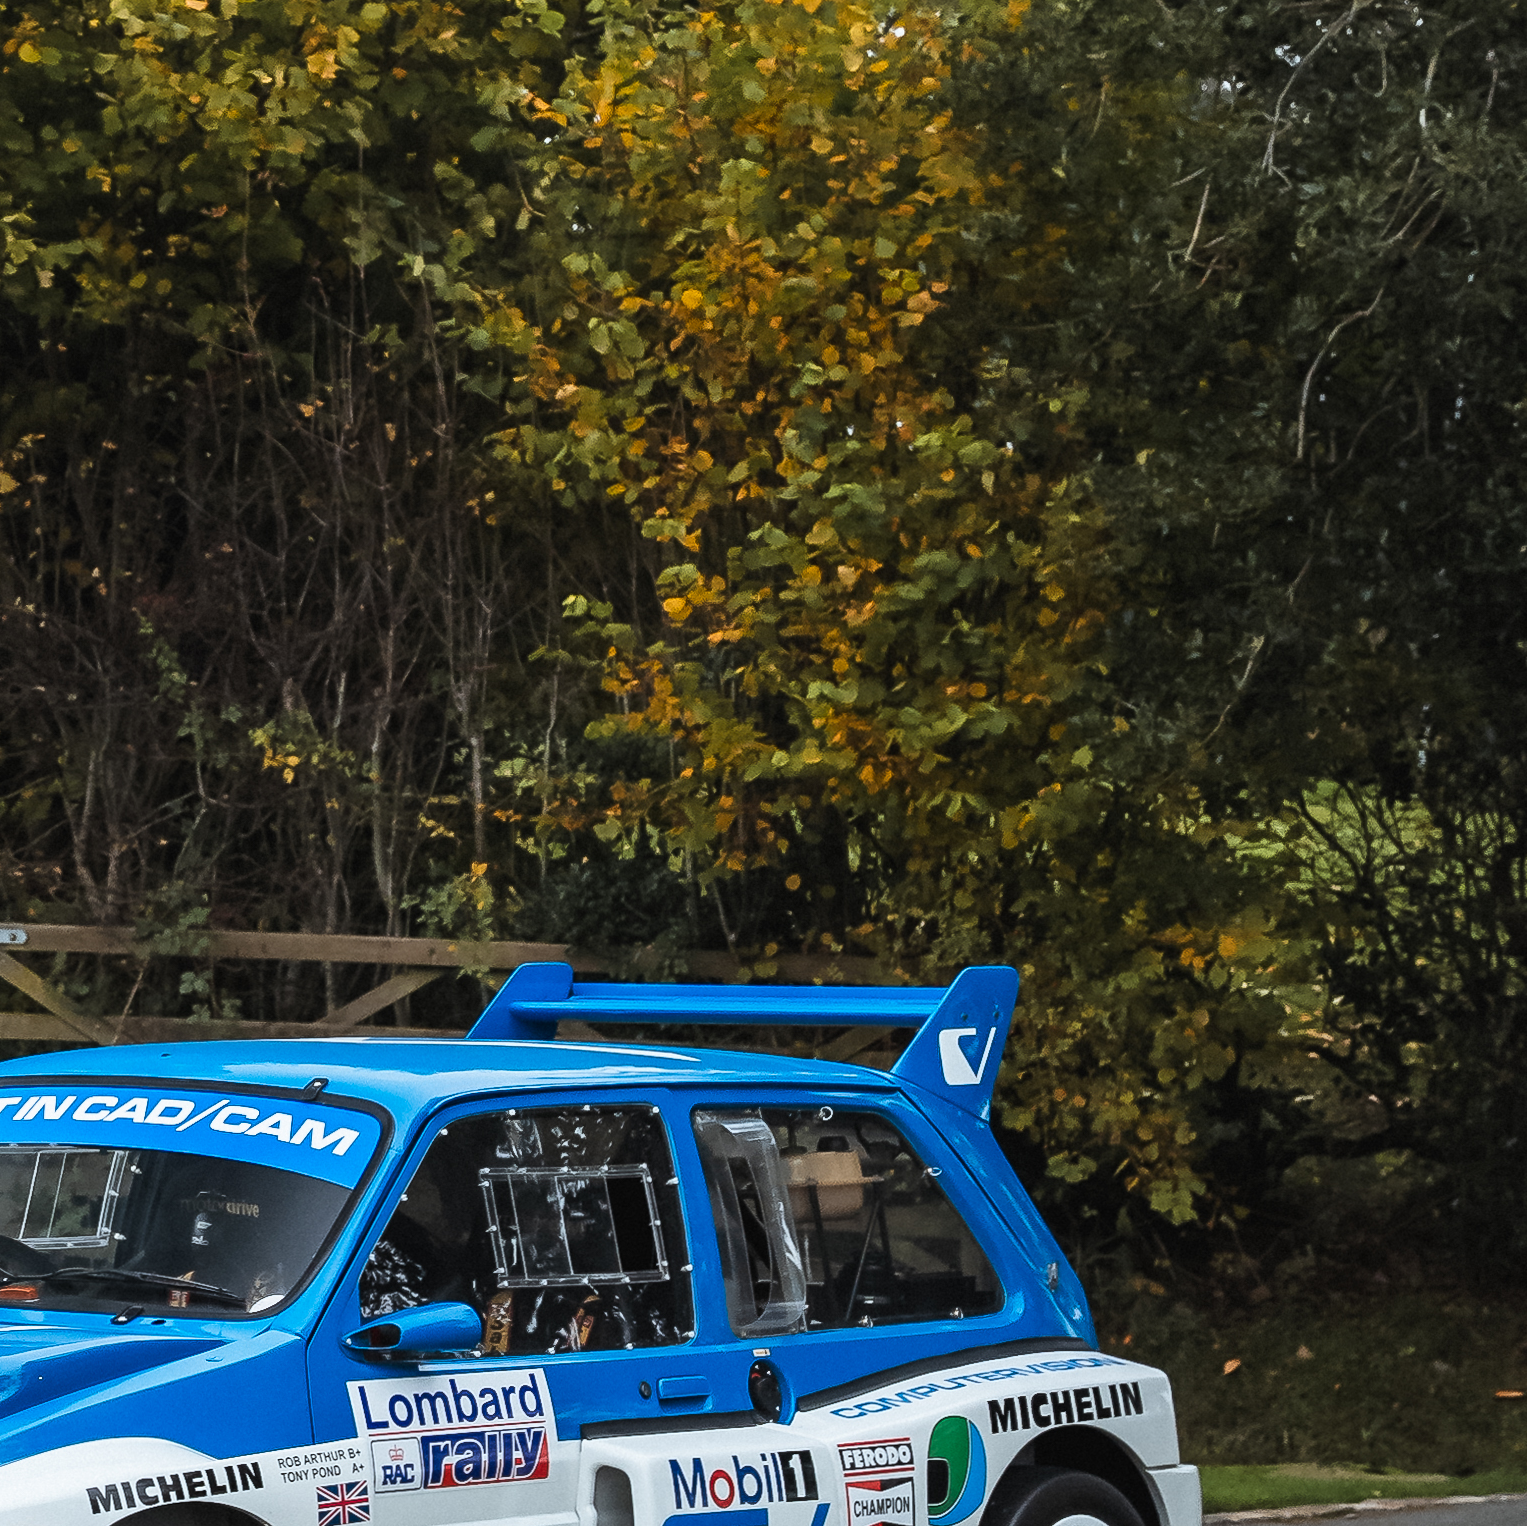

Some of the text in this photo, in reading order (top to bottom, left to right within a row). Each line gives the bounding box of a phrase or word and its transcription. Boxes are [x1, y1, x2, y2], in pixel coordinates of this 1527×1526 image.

[15, 1095, 78, 1121] IN
[72, 1095, 360, 1156] CAD/CAM
[358, 1373, 544, 1429] Lombard
[830, 1356, 1127, 1420] COMPUTERVISION
[987, 1381, 1144, 1434] MICHELIN
[277, 1448, 362, 1469] ROB ARTHUR B+
[281, 1462, 365, 1483] TONY POND A+
[381, 1464, 415, 1486] RAC
[428, 1428, 546, 1486] rally
[668, 1452, 784, 1509] Mobil
[842, 1445, 911, 1470] FERODO
[86, 1461, 264, 1515] MICHELIN
[853, 1496, 910, 1518] CHAMPION
